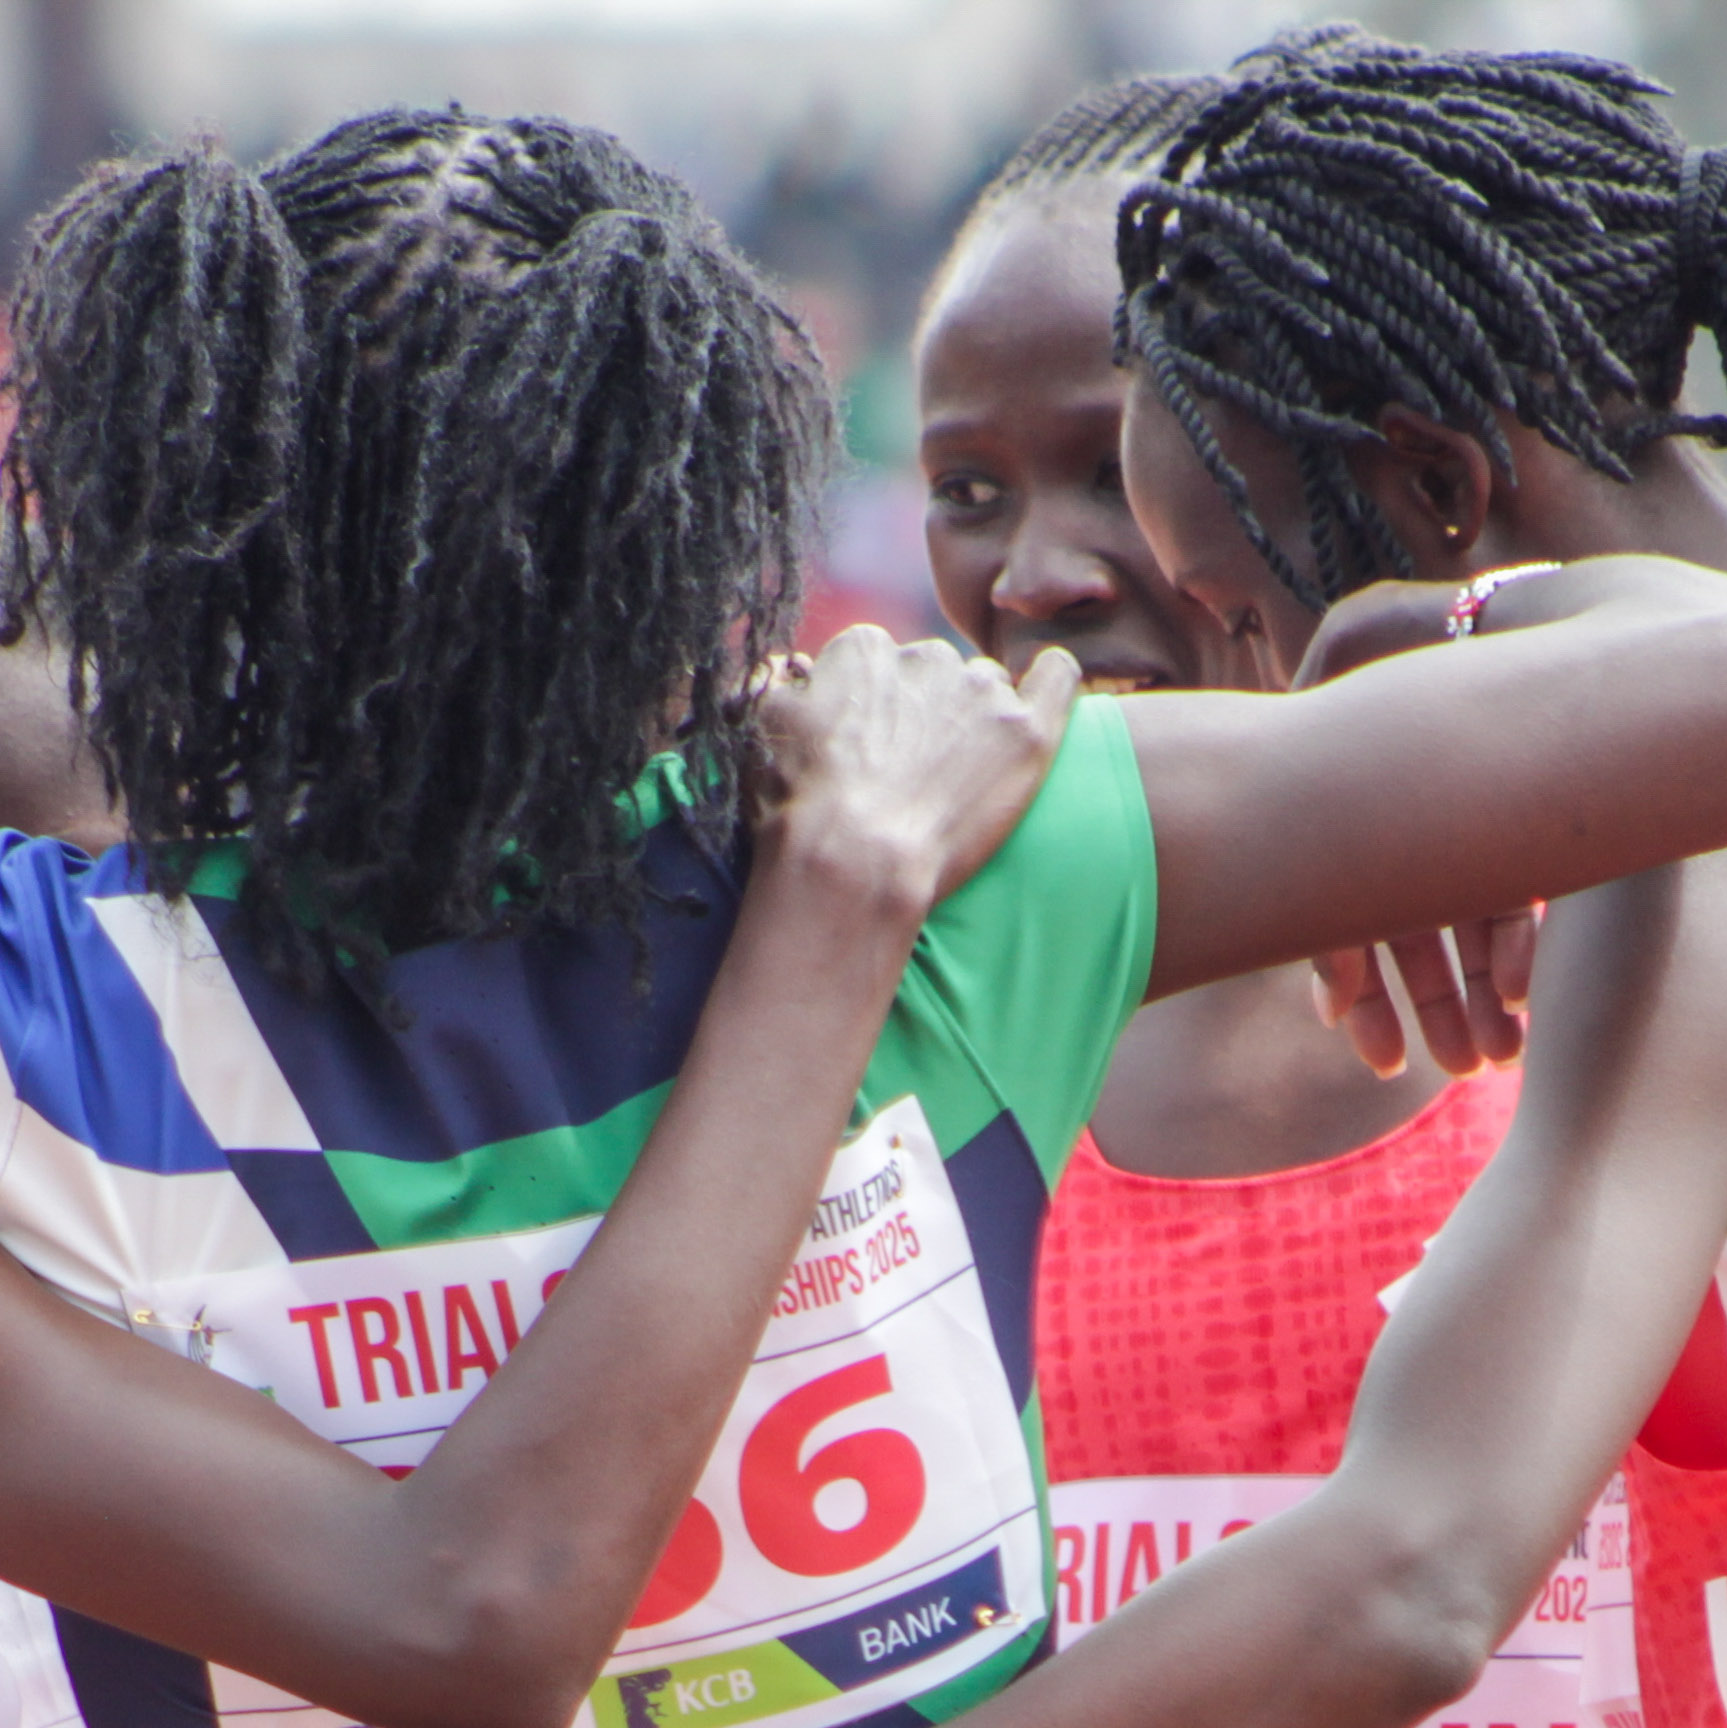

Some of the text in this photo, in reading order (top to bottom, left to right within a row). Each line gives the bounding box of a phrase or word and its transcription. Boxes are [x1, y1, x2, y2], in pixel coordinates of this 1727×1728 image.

[865, 1209, 922, 1284] 2025
[288, 1269, 570, 1410] TRIA
[1534, 1574, 1588, 1623] 202
[675, 1597, 958, 1716] KCB BANK
